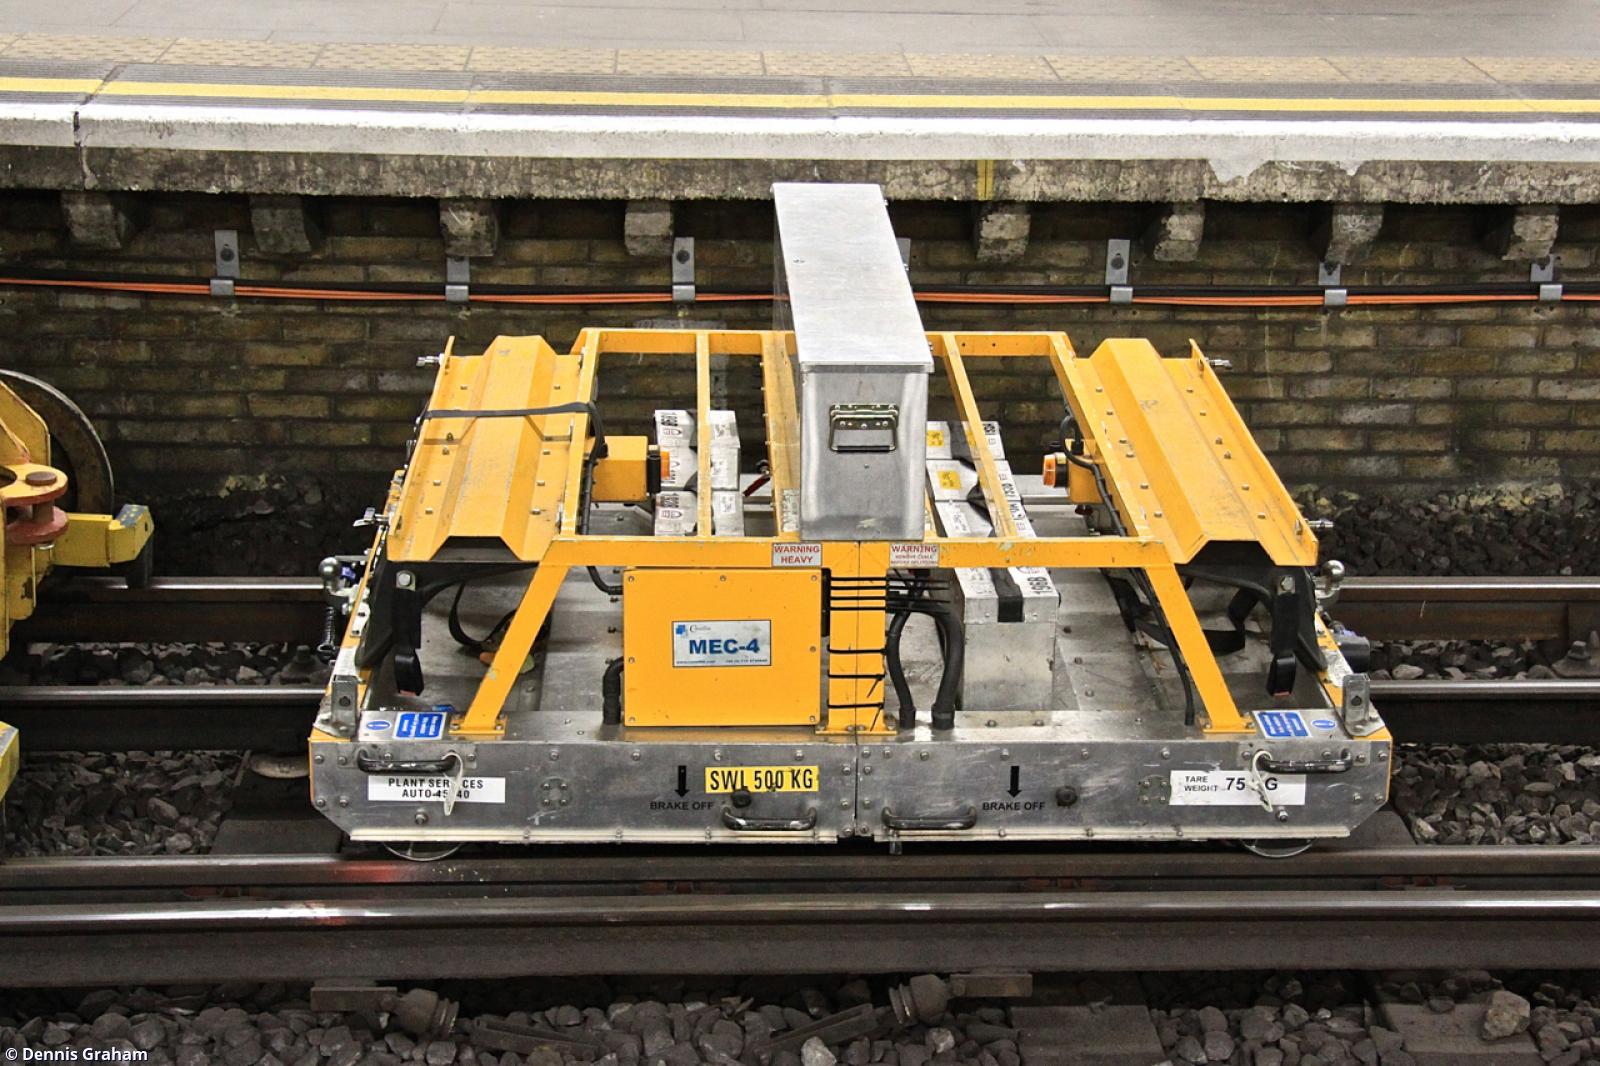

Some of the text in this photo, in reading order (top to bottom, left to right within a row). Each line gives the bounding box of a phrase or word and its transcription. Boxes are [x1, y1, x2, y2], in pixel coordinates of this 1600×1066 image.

[774, 545, 821, 553] WARNING
[891, 545, 938, 553] WARNING
[780, 556, 814, 564] HEAVY
[689, 638, 760, 654] MEC-4
[388, 778, 484, 789] PLANT SERCES
[710, 769, 813, 789] SWL 500 KG
[1185, 775, 1208, 783] TARE
[1225, 777, 1246, 791] 75
[402, 789, 470, 799] AUTO-4540
[650, 801, 715, 810] BRAKE OFF
[982, 801, 1046, 811] BRAKE OFF
